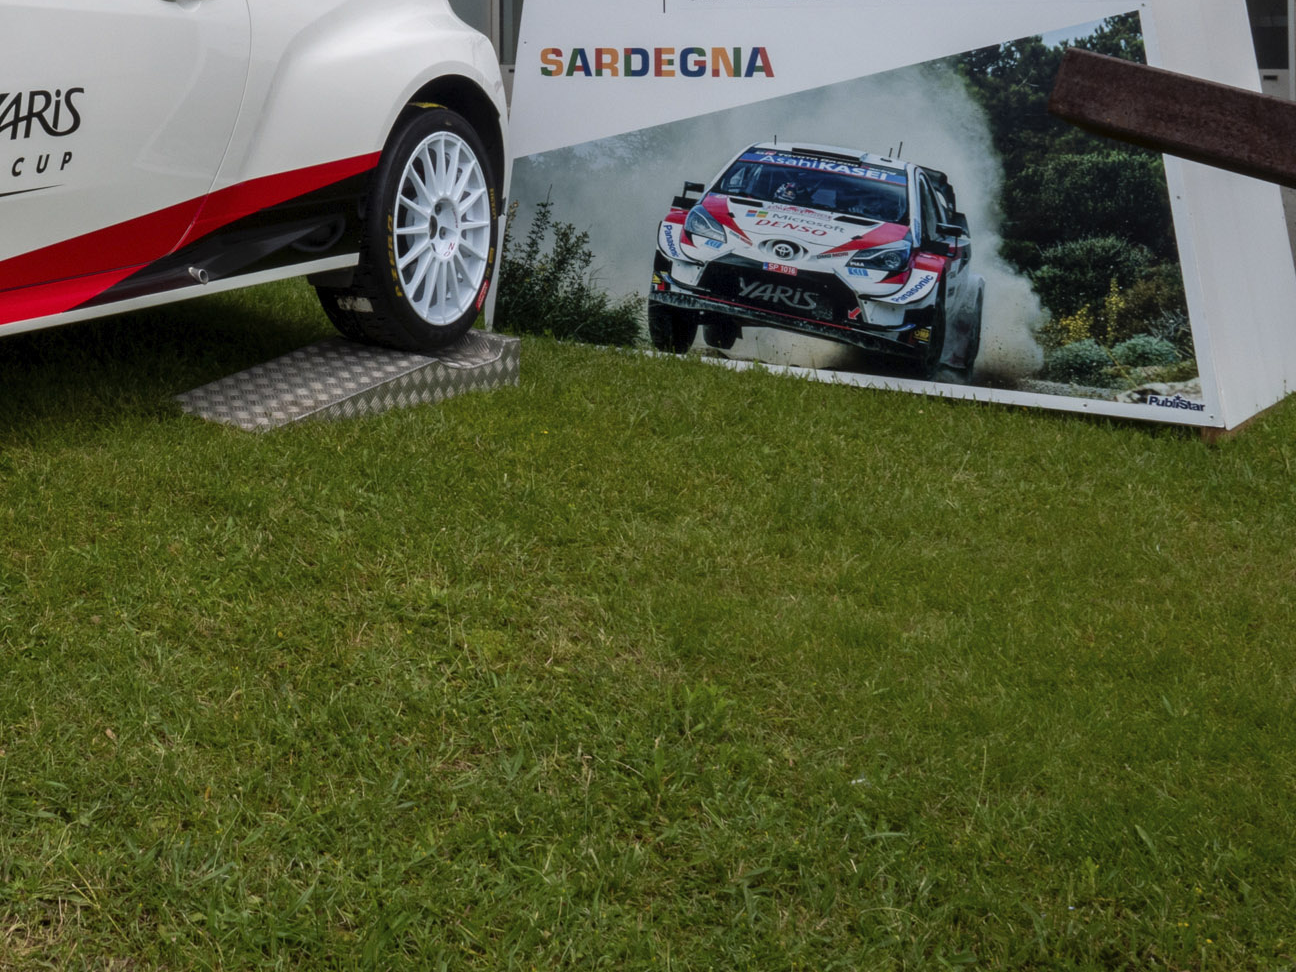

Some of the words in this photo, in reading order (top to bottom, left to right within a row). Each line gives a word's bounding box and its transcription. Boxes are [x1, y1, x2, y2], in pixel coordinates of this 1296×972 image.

[540, 46, 775, 78] SARDEGNA
[11, 151, 73, 177] CUP
[755, 219, 827, 237] DENSO
[772, 213, 845, 234] Microsoft
[663, 223, 680, 258] Panasonic
[768, 263, 779, 271] SP
[891, 273, 934, 303] Panasonic
[1148, 395, 1205, 412] PubliStar
